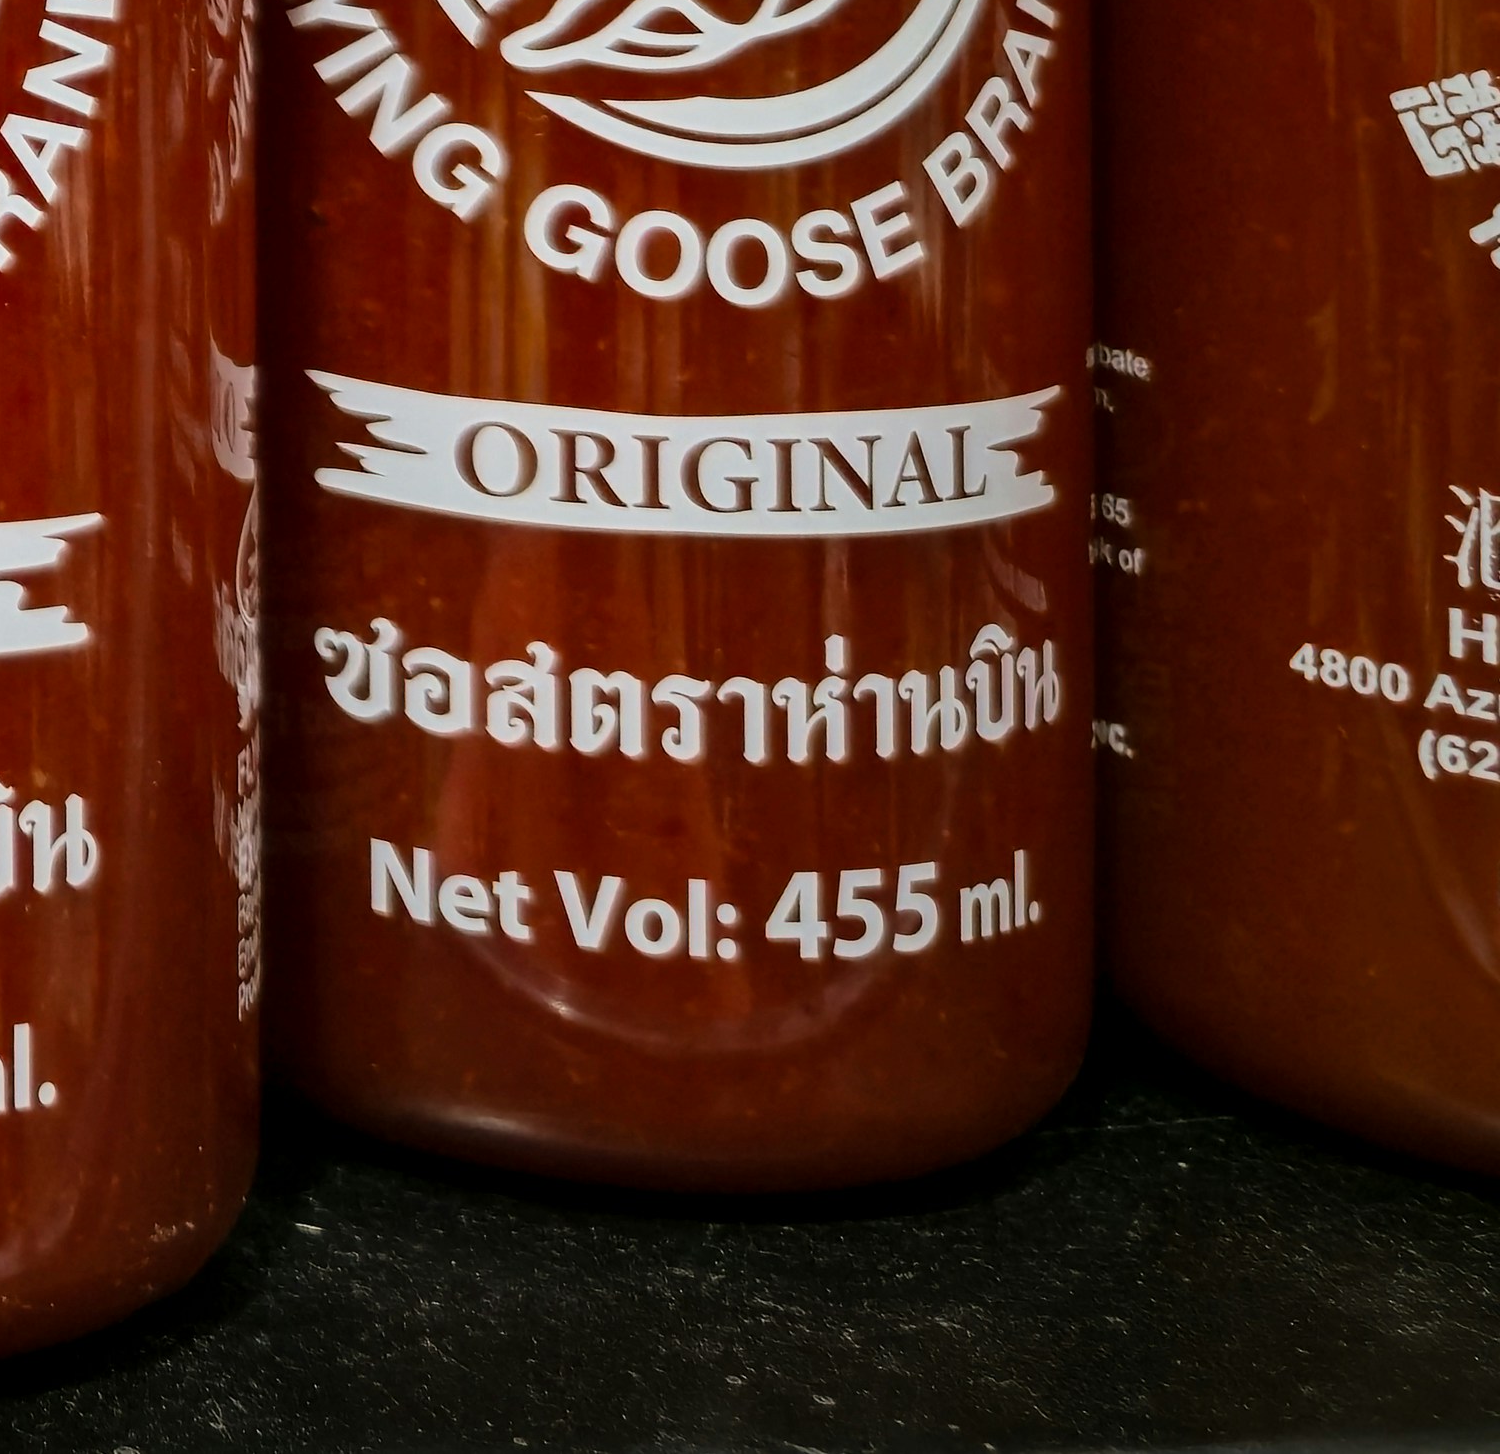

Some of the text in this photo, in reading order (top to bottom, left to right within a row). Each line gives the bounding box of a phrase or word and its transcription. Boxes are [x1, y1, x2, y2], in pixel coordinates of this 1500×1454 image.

[522, 180, 927, 308] GOOSE
[454, 420, 989, 514] ORIGINAL
[1289, 642, 1411, 704] 4800
[368, 838, 1040, 961] Net Vol: 455 ml.
